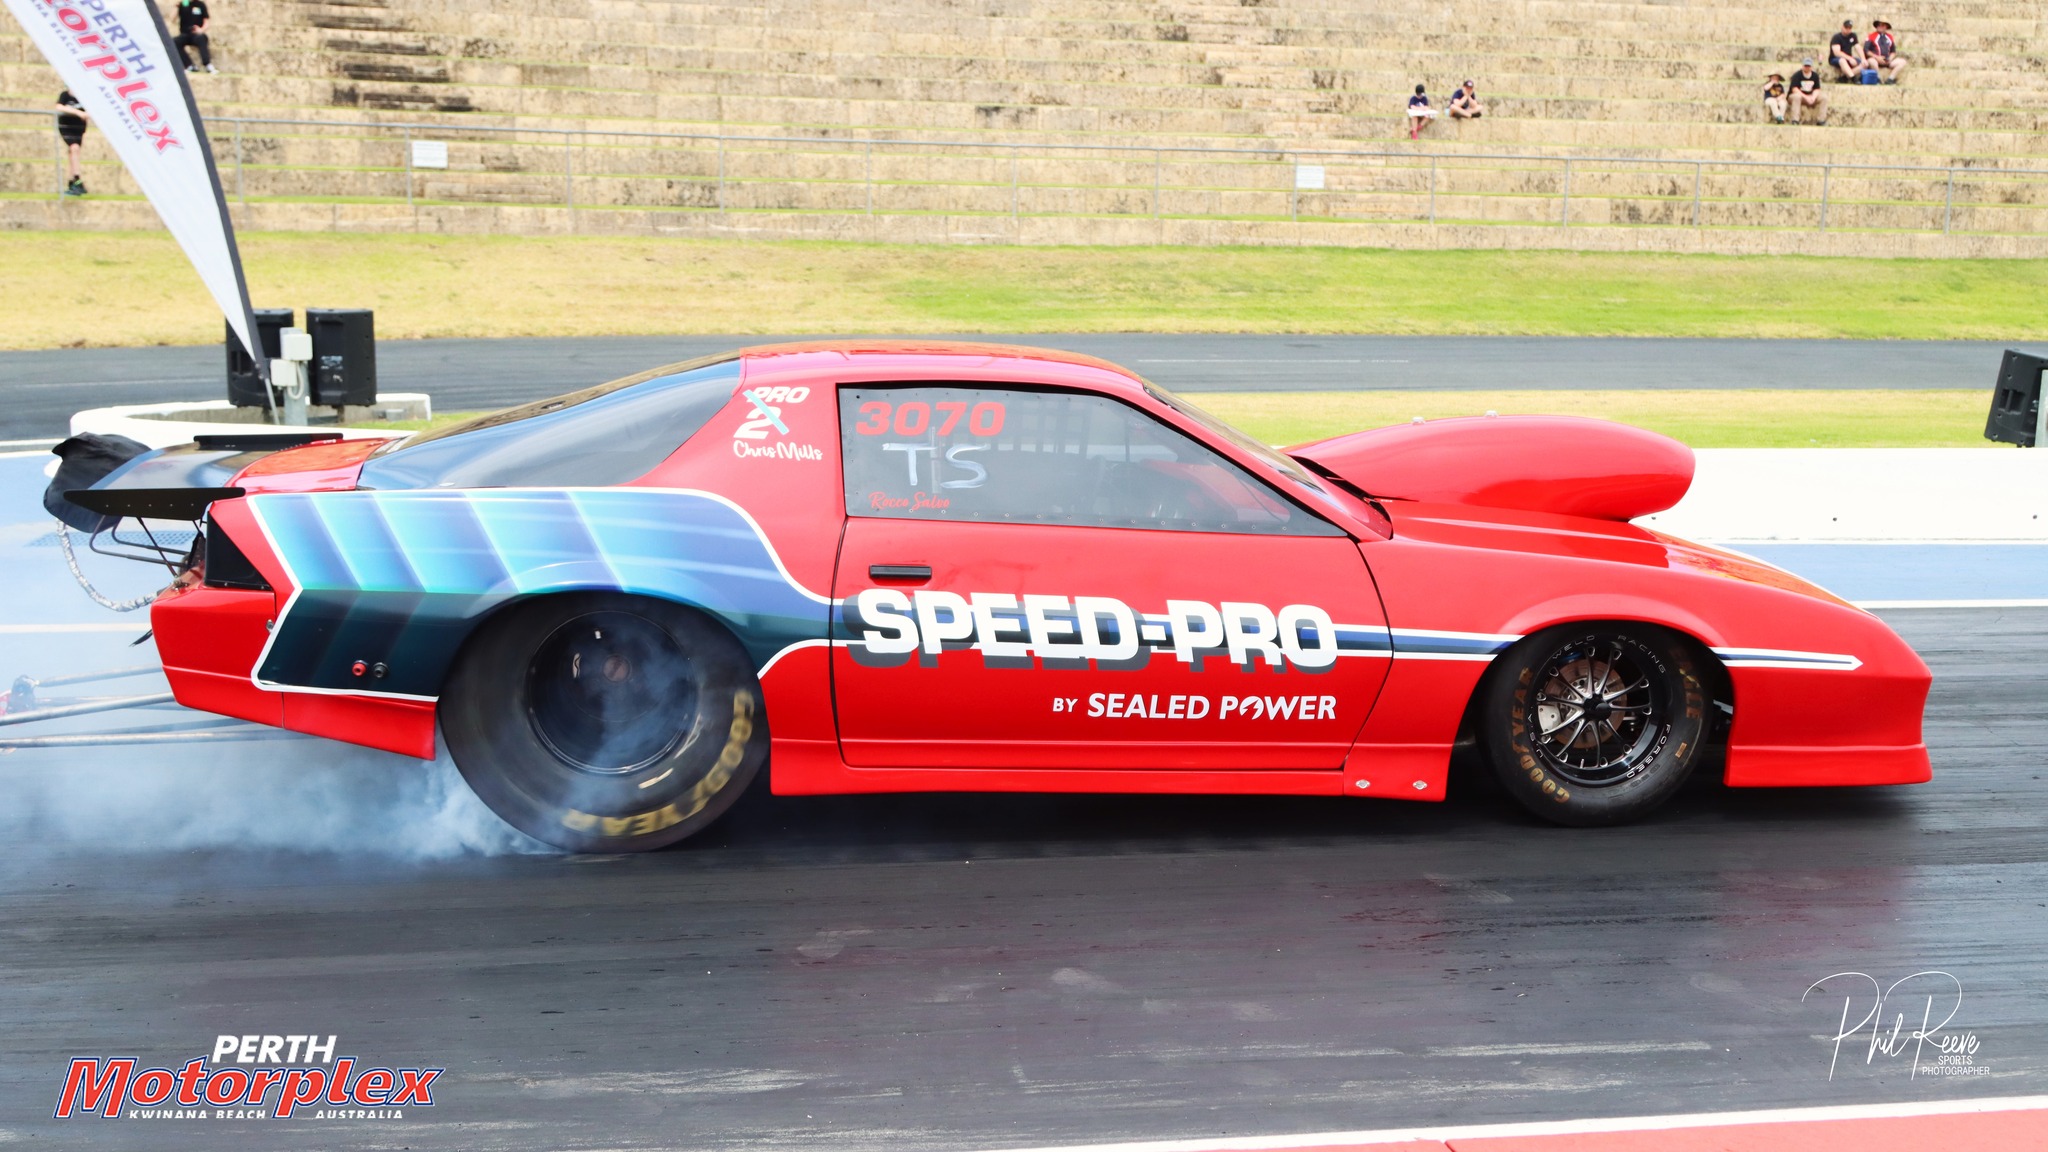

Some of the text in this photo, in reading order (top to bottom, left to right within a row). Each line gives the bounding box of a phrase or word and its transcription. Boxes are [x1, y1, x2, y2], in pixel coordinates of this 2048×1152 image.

[80, 0, 155, 74] PERTH
[42, 0, 183, 152] orplex
[99, 85, 142, 141] AUSTRALIA
[746, 386, 811, 404] PRO
[733, 405, 782, 440] 2
[855, 401, 1006, 437] 3070
[733, 440, 823, 461] Chris Mills
[868, 491, 950, 511] Rocco Salvo
[852, 587, 1339, 670] SPEED-PRO
[1552, 634, 1667, 675] WELD RACING
[1053, 692, 1337, 721] BY SEALED POWER
[1626, 723, 1672, 779] FORGED
